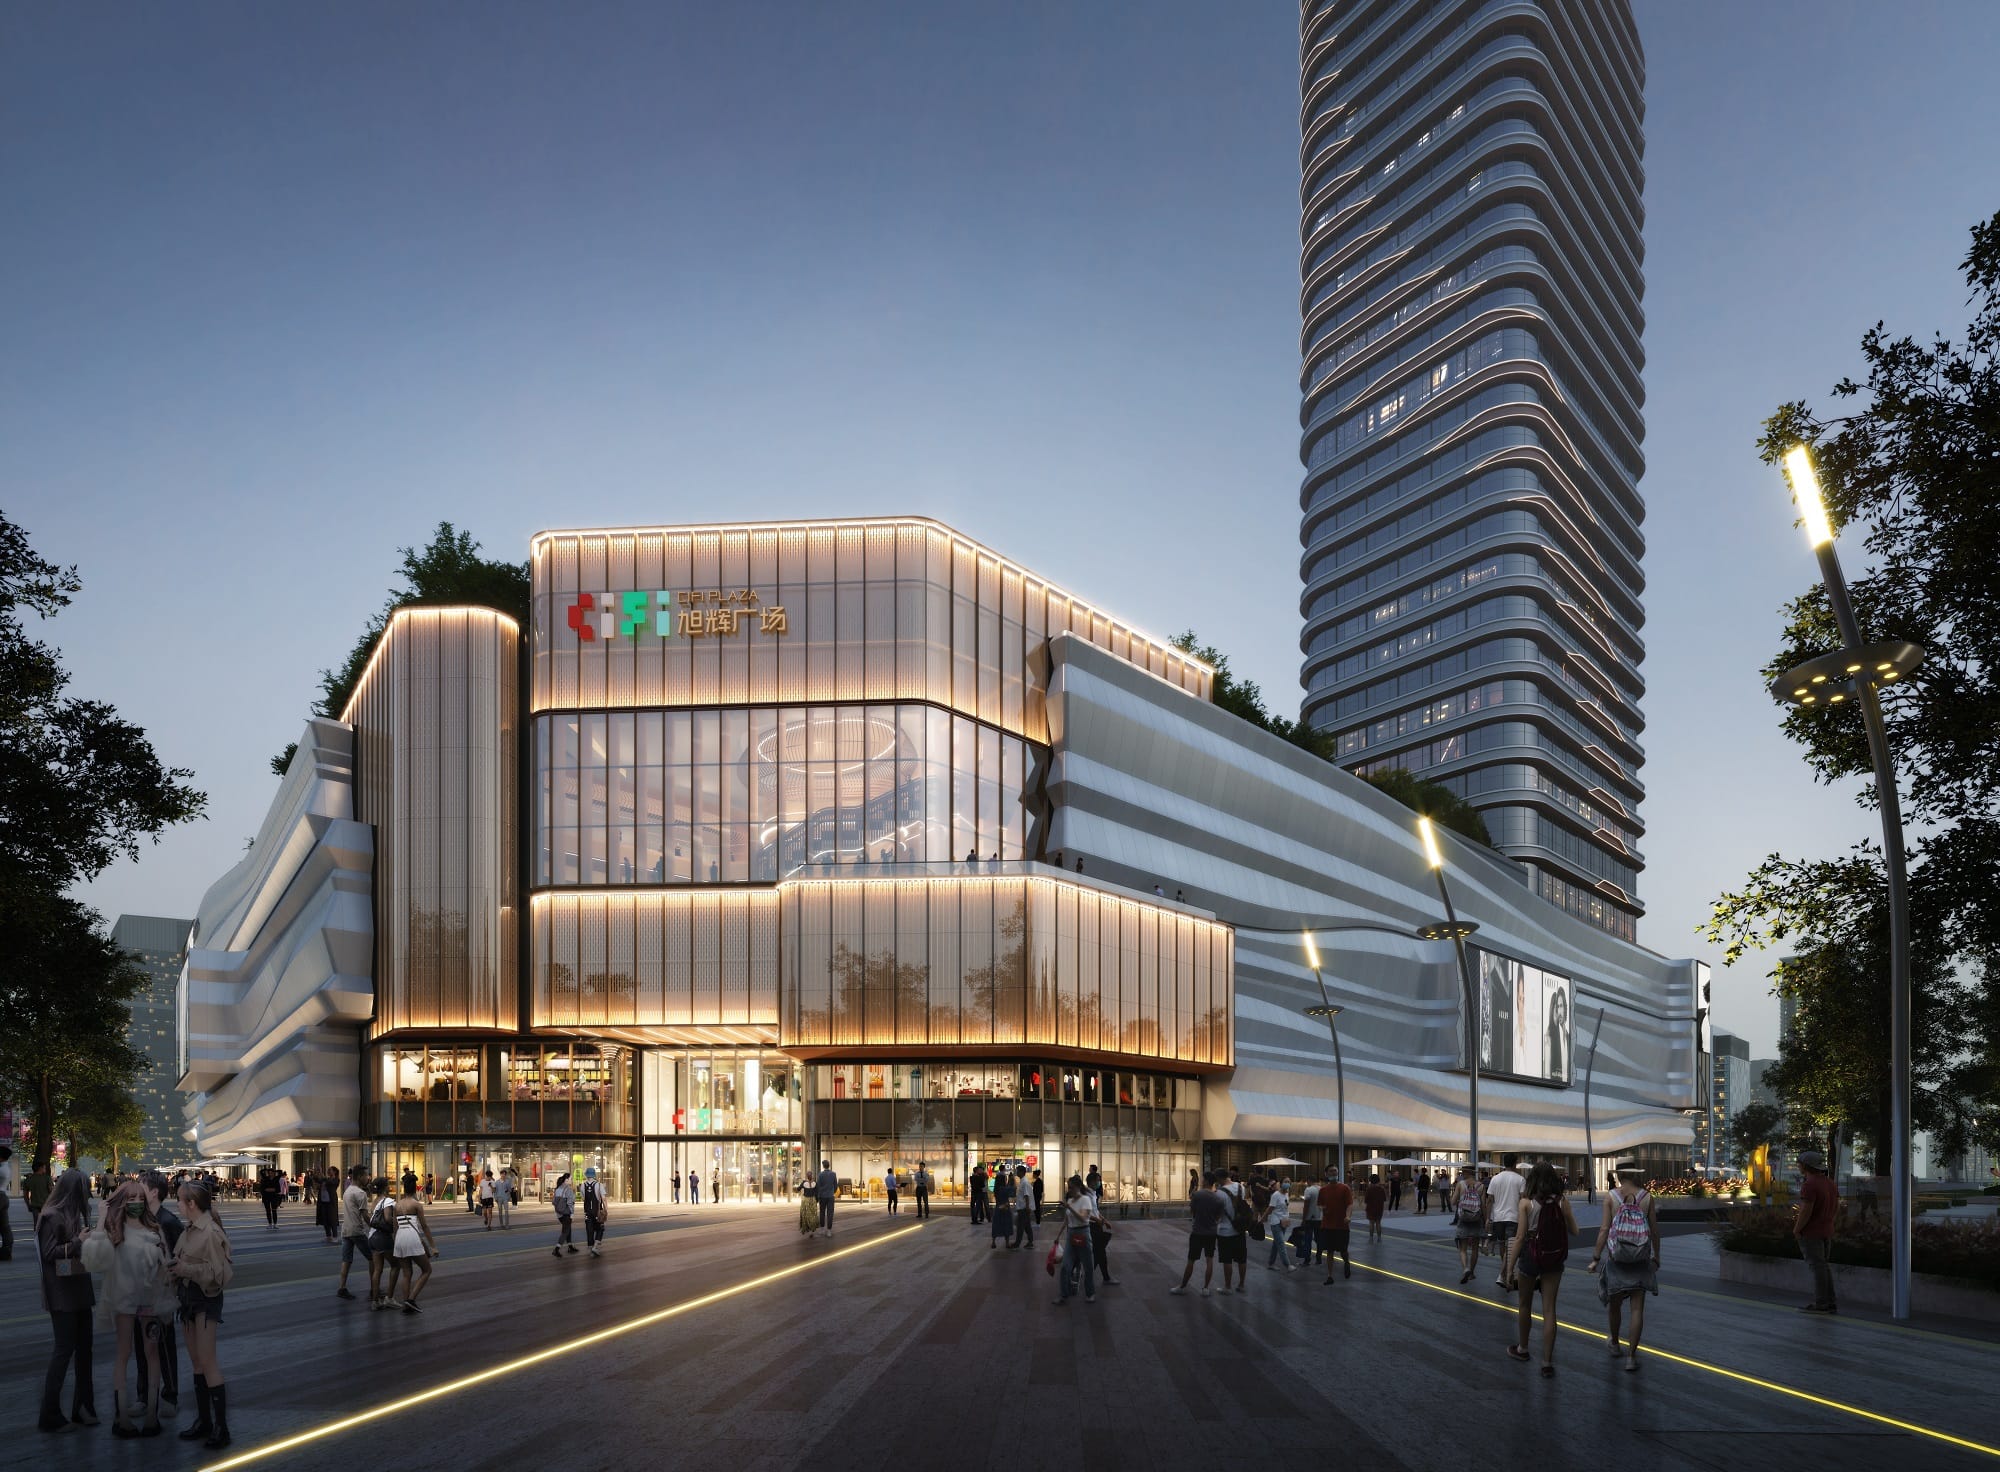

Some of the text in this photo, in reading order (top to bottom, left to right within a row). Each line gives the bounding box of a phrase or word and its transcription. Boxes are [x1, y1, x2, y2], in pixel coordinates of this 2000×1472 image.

[708, 590, 758, 601] PLAZA
[678, 606, 786, 633] 旭辉广场
